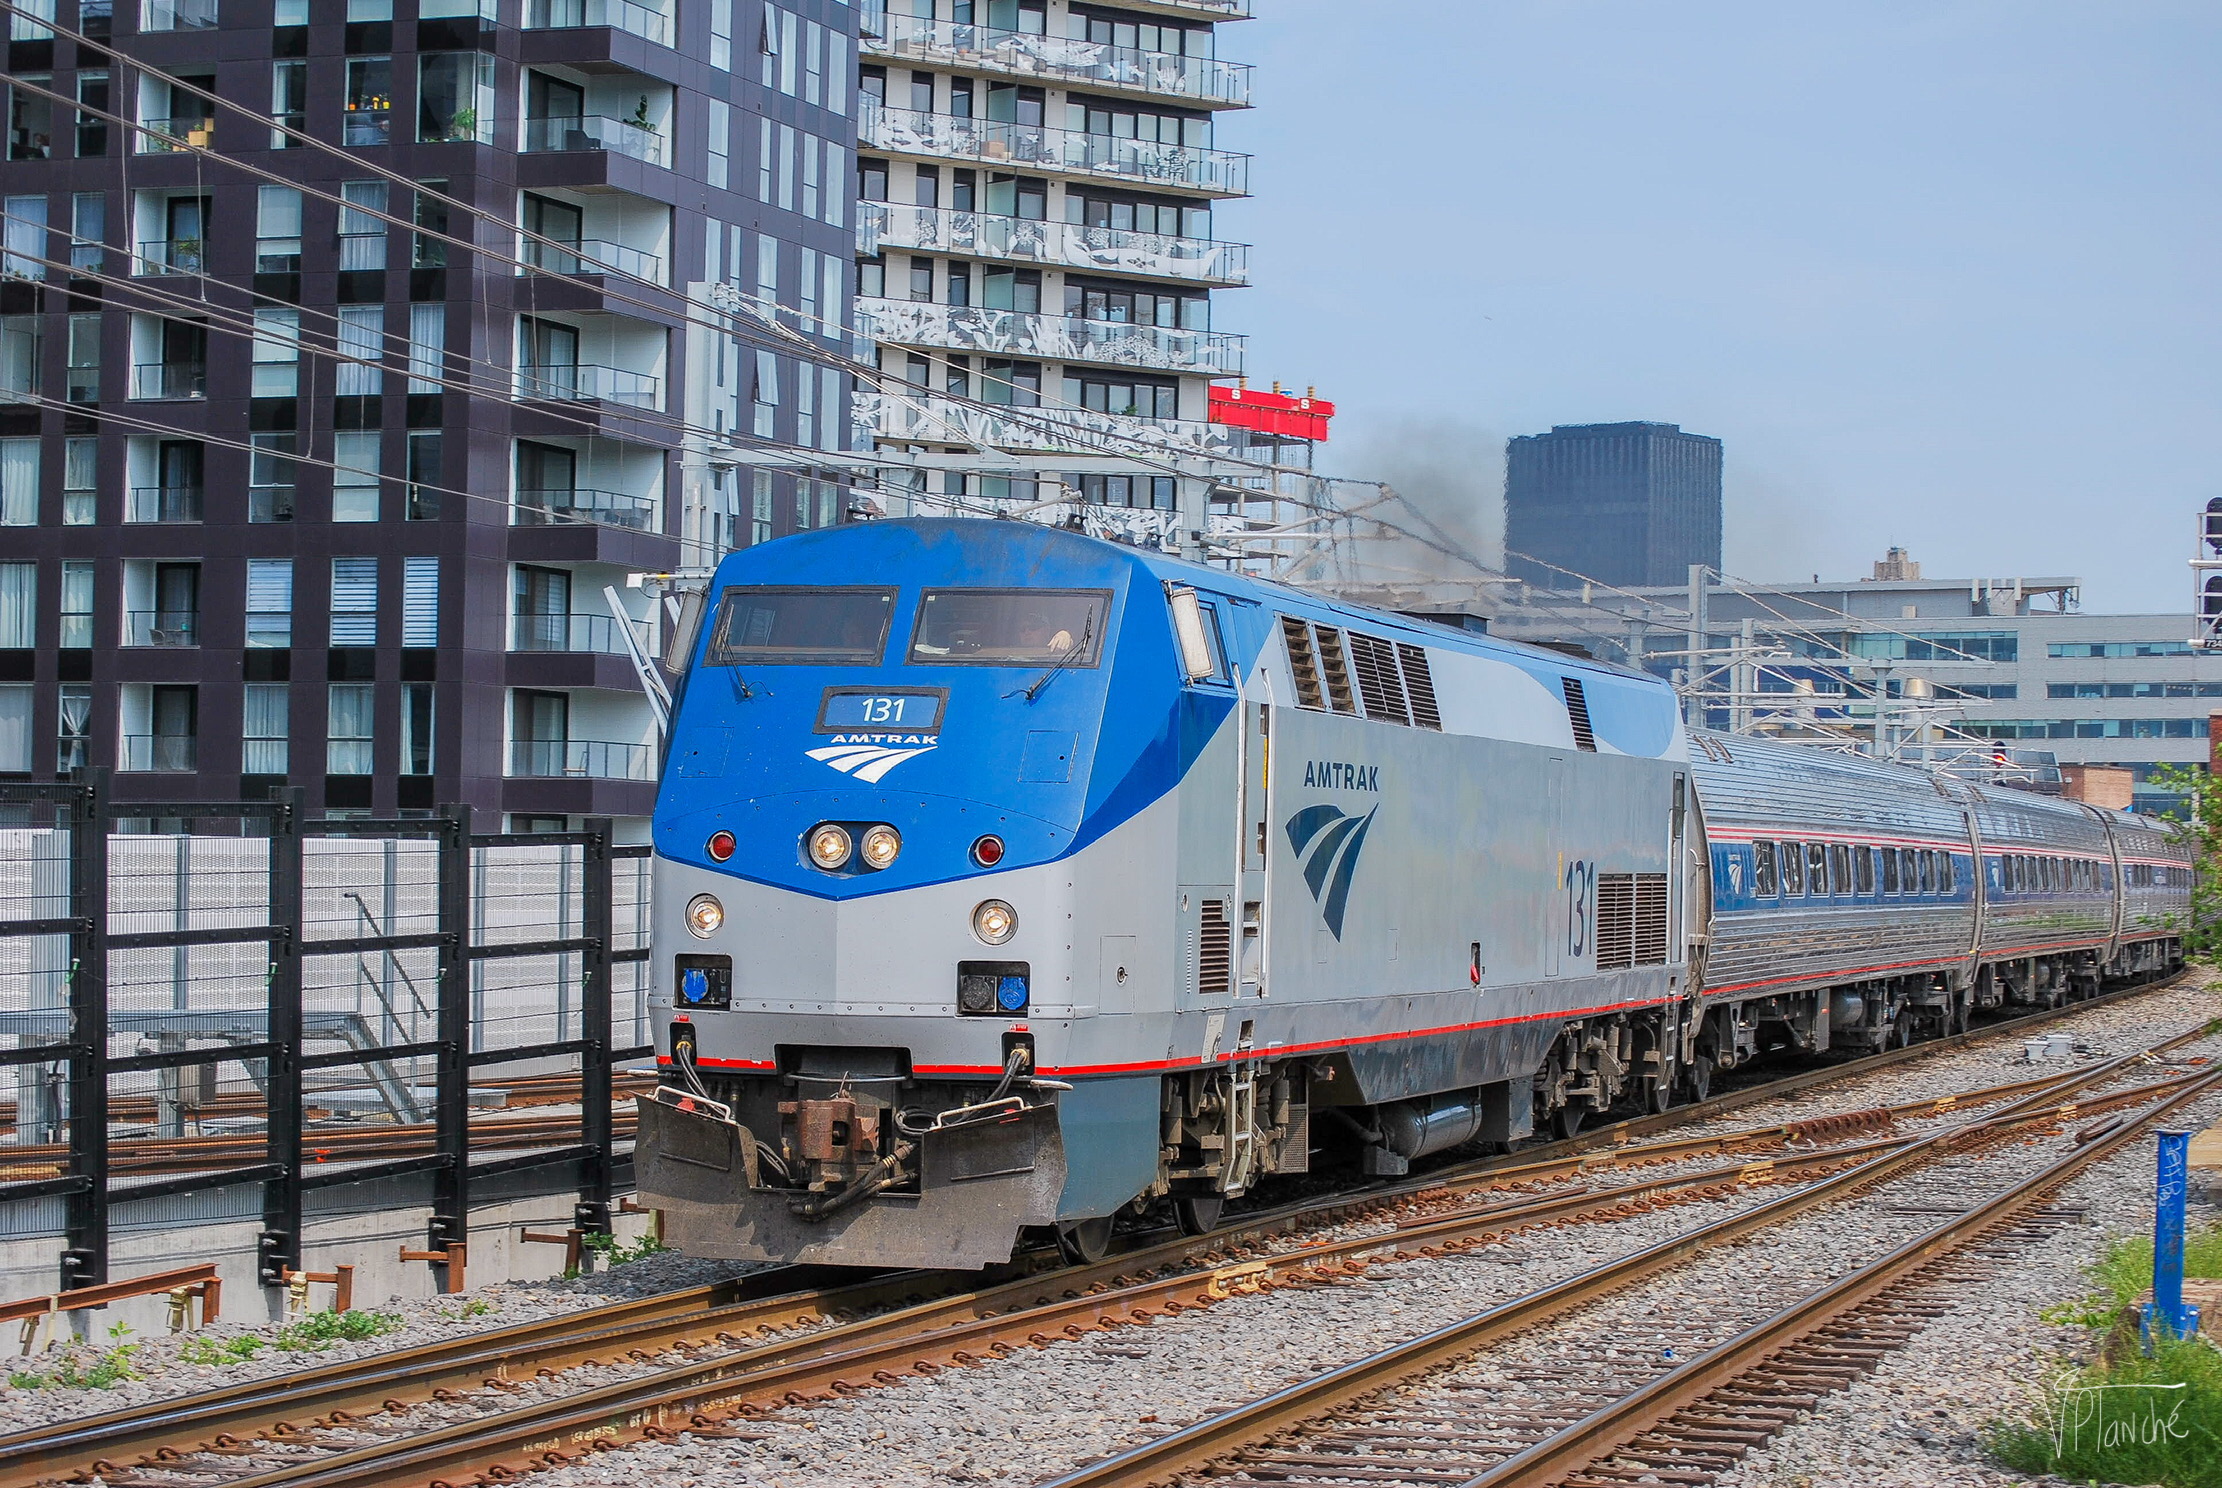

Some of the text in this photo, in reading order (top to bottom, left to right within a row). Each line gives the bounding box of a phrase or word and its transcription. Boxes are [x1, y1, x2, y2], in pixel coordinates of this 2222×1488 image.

[1231, 389, 1241, 400] S
[1300, 398, 1310, 409] S
[862, 697, 905, 722] 131
[830, 734, 939, 745] AMTRAK
[1303, 760, 1379, 792] AMTRAK
[1566, 860, 1594, 957] 131
